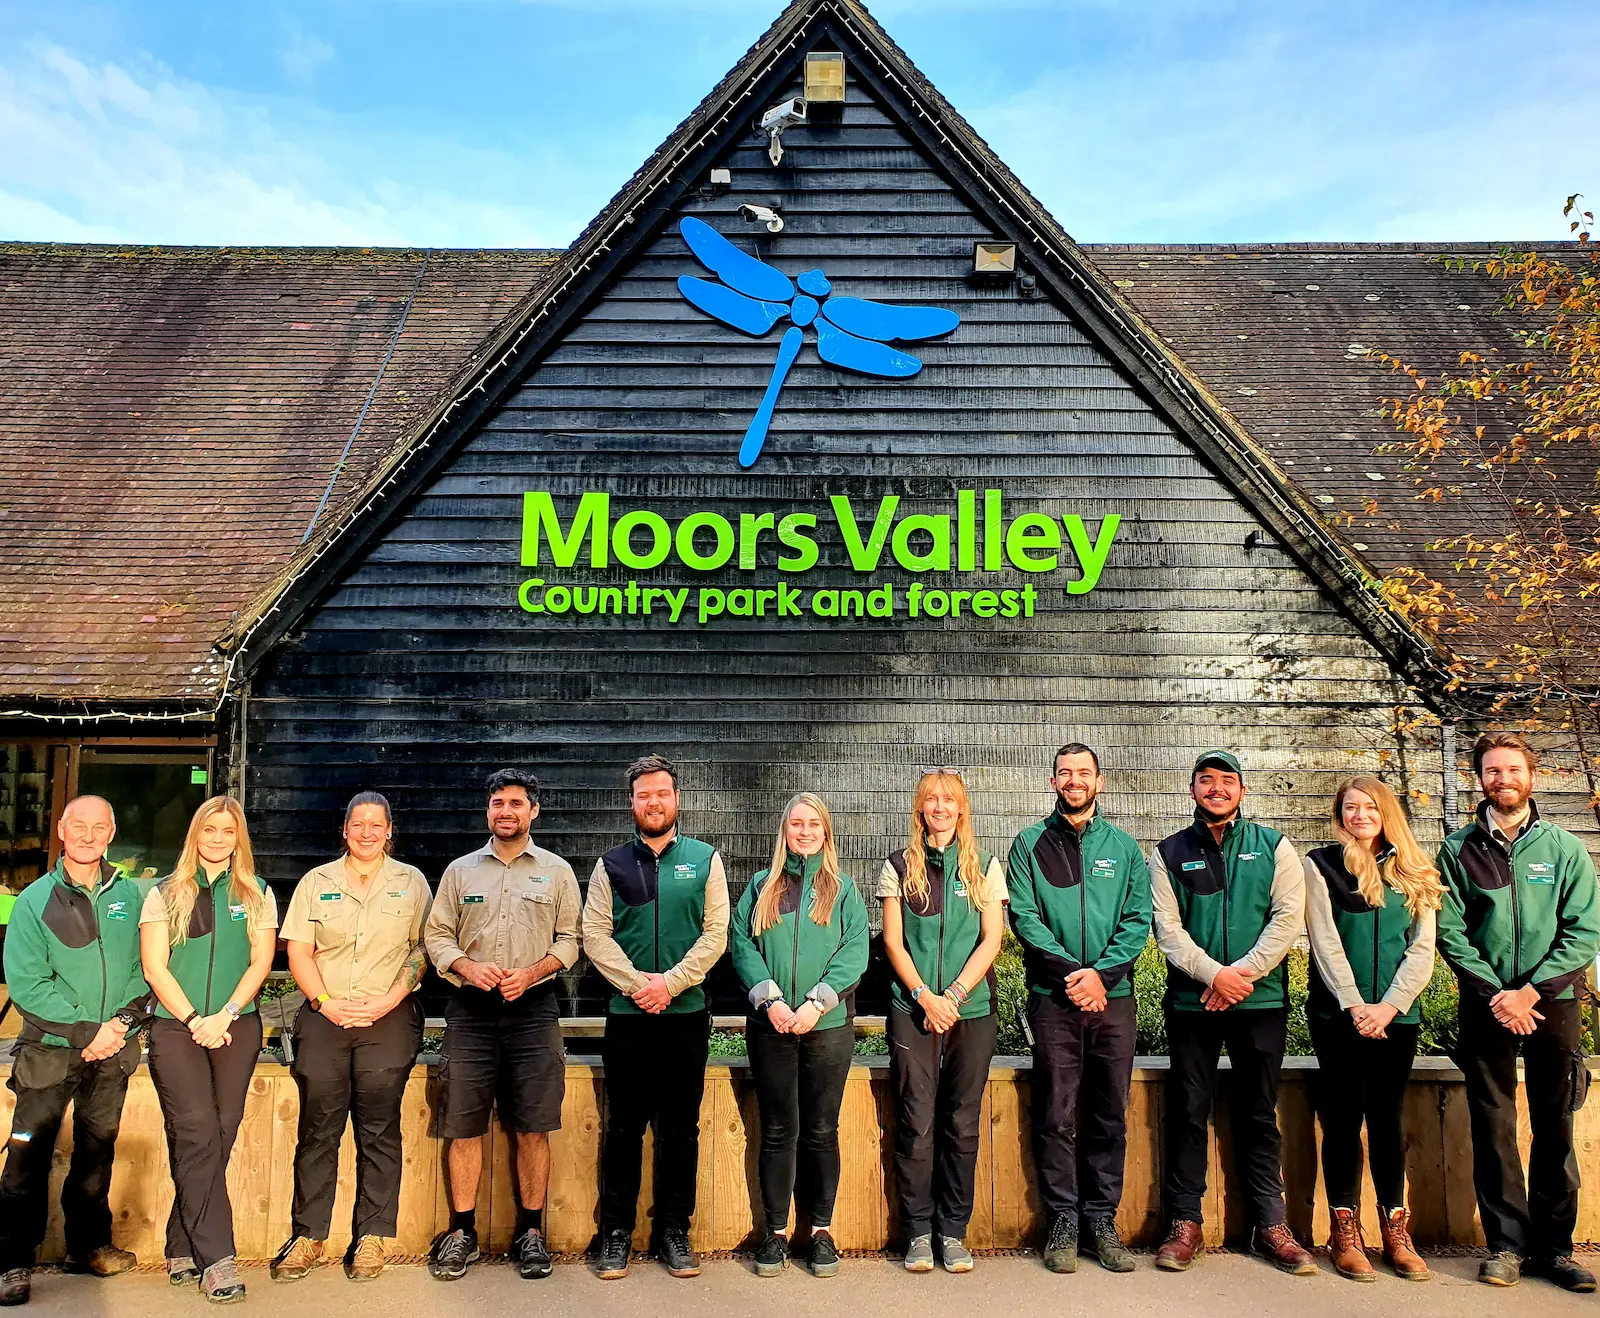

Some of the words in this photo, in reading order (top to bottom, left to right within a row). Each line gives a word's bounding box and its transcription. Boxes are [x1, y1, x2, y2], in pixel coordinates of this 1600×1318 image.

[520, 491, 819, 571] Moors
[831, 489, 1122, 595] Valley
[517, 578, 689, 623] Country
[699, 582, 802, 623] park
[812, 583, 893, 617] and
[906, 583, 1038, 617] forest
